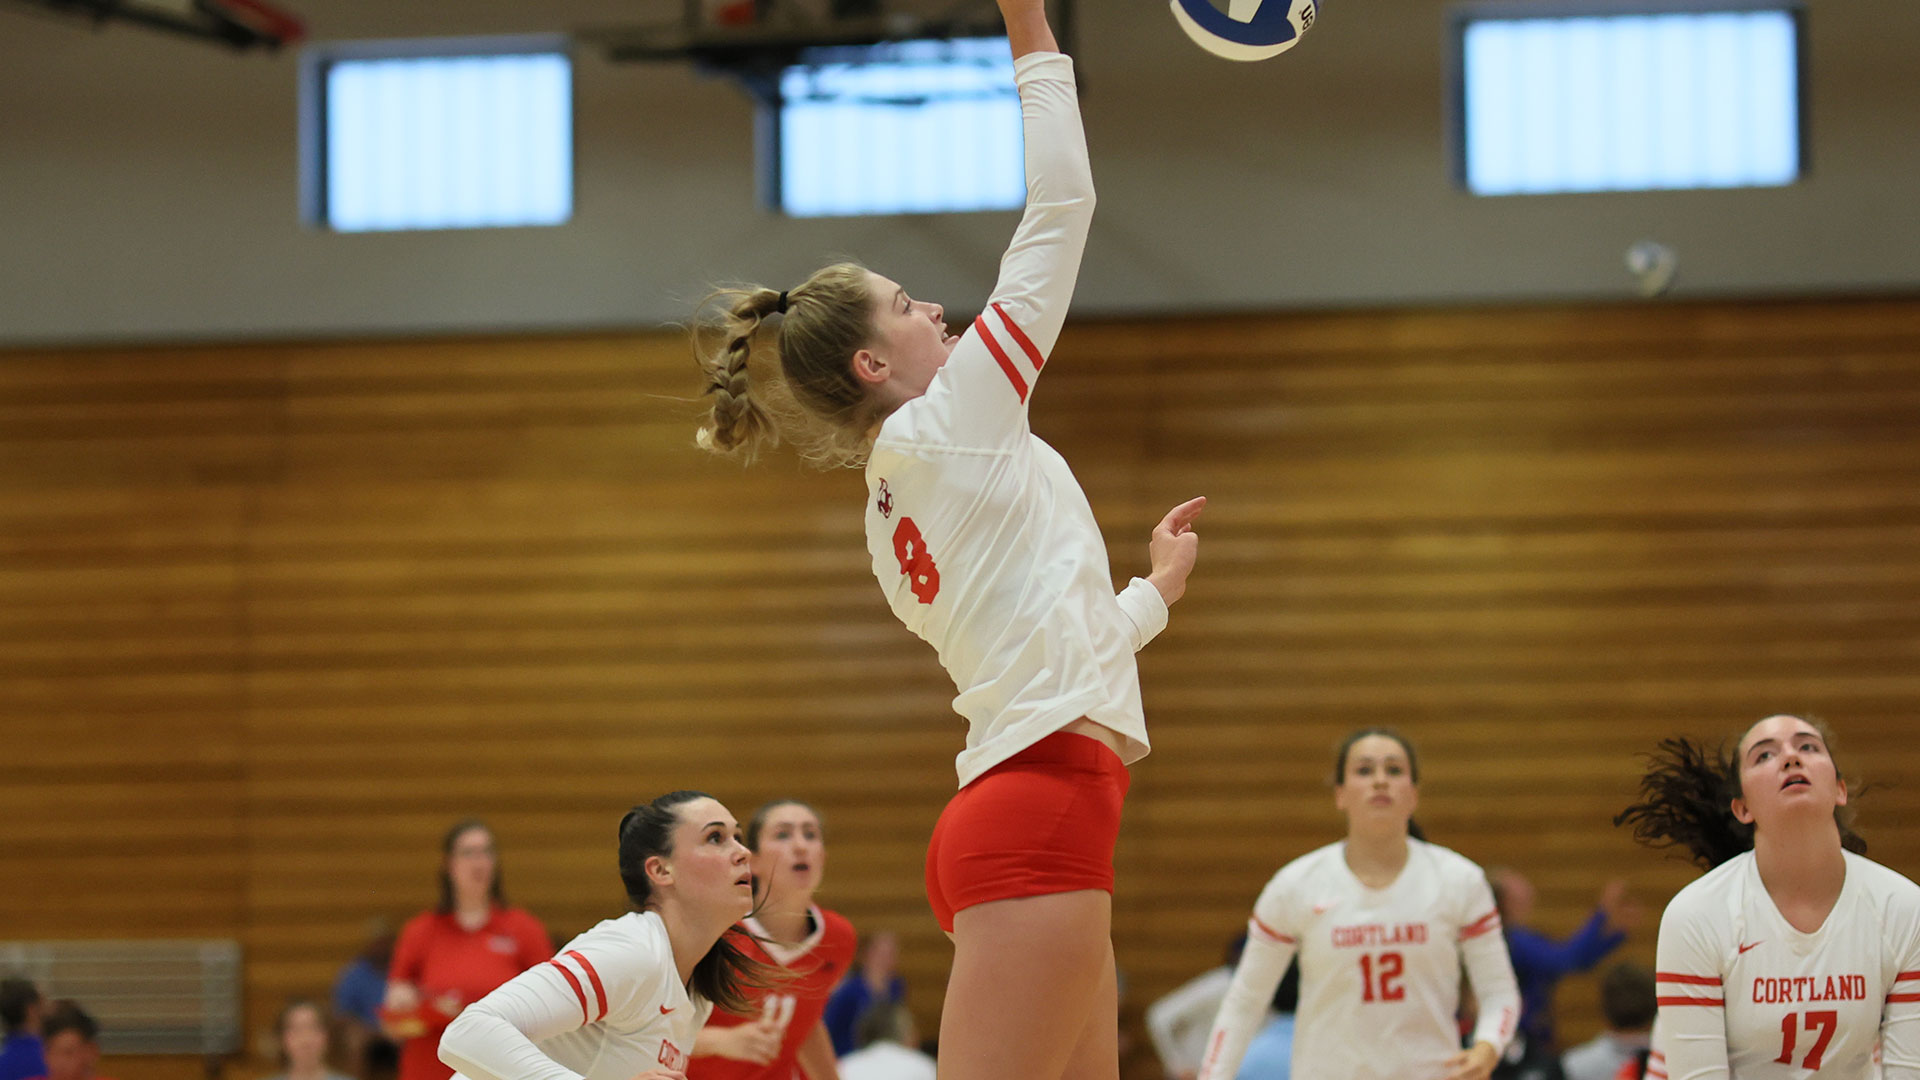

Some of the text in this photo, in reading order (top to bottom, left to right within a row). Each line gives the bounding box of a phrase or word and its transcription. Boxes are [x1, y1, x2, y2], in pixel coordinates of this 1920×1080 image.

[893, 517, 940, 604] 8
[1332, 923, 1428, 948] CORTLAND
[1360, 952, 1405, 1002] 12
[1752, 974, 1867, 1004] CORTLAND
[1773, 1010, 1838, 1071] 17
